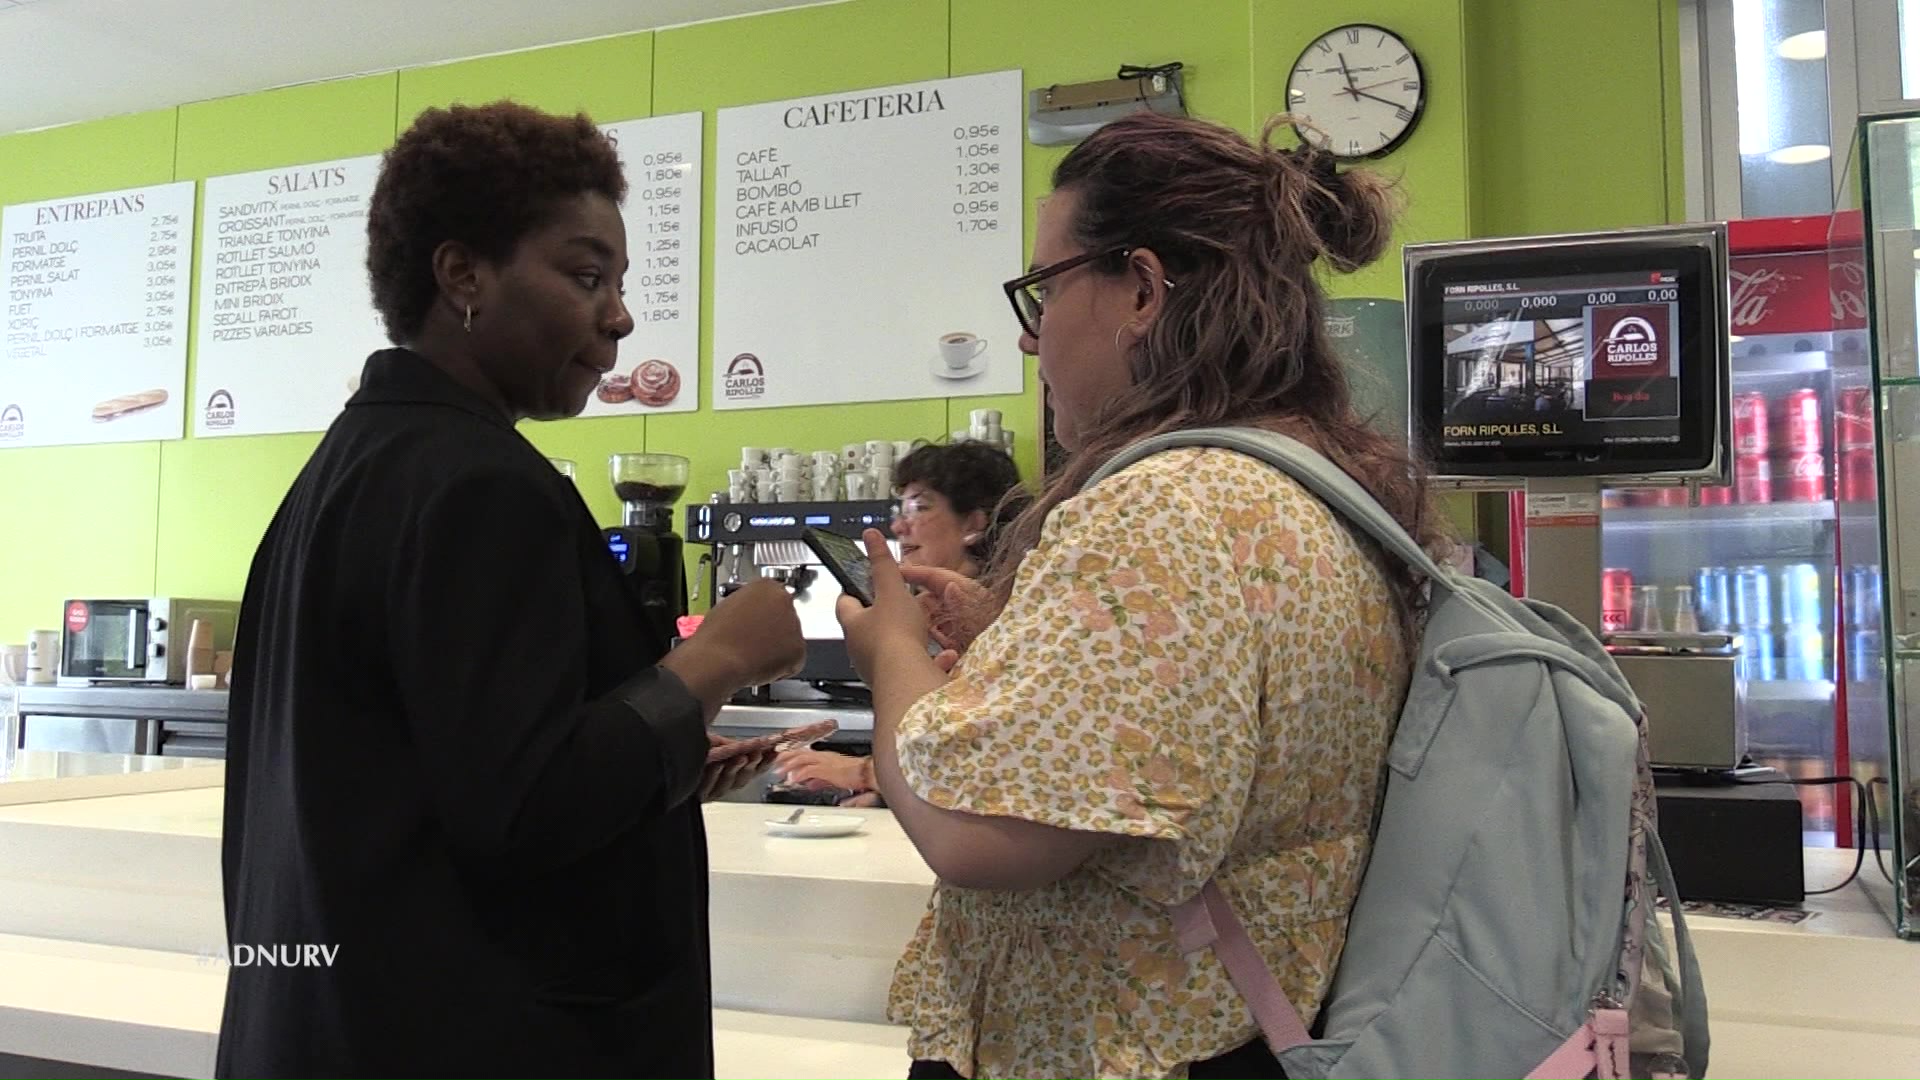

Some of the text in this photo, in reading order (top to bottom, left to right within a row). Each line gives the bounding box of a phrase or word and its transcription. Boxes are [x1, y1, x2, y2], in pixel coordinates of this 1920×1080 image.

[784, 89, 945, 129] CAFETERIA
[267, 167, 346, 195] SALATS
[736, 164, 791, 182] TALLAT
[737, 180, 802, 201] BOMBÓ
[35, 194, 146, 226] ENTREPANS
[219, 200, 279, 219] SANDVITX
[780, 197, 819, 213] AMB
[825, 192, 862, 210] LLET
[218, 214, 286, 234] CROISSANT
[737, 216, 798, 237] INFUSIÓ
[14, 230, 46, 244] TRUITA
[218, 225, 330, 248] TRIANGLE TONYINA
[736, 233, 820, 255] CACAOLAT
[12, 247, 46, 259] PERNIL
[216, 247, 265, 265] ROTLLET
[12, 256, 66, 272] FORMATGE
[215, 258, 321, 280] ROTLLET TONYINA
[10, 269, 80, 288] PERNIL SALAT
[270, 274, 313, 290] BRIOIX
[9, 287, 54, 302] TONYINA
[214, 292, 284, 310] MINI BRIOIX
[1521, 296, 1557, 308] 0,000
[1587, 292, 1616, 305] 0,00
[1648, 288, 1678, 302] 0,00
[213, 311, 256, 326] SECALL
[80, 322, 140, 337] FORMATGE
[213, 321, 313, 342] PIZZES VARIADES
[1607, 342, 1658, 354] CARLOS
[1607, 352, 1658, 362] RIPOLLES
[725, 377, 765, 388] CARLOS
[1444, 425, 1477, 437] FORN
